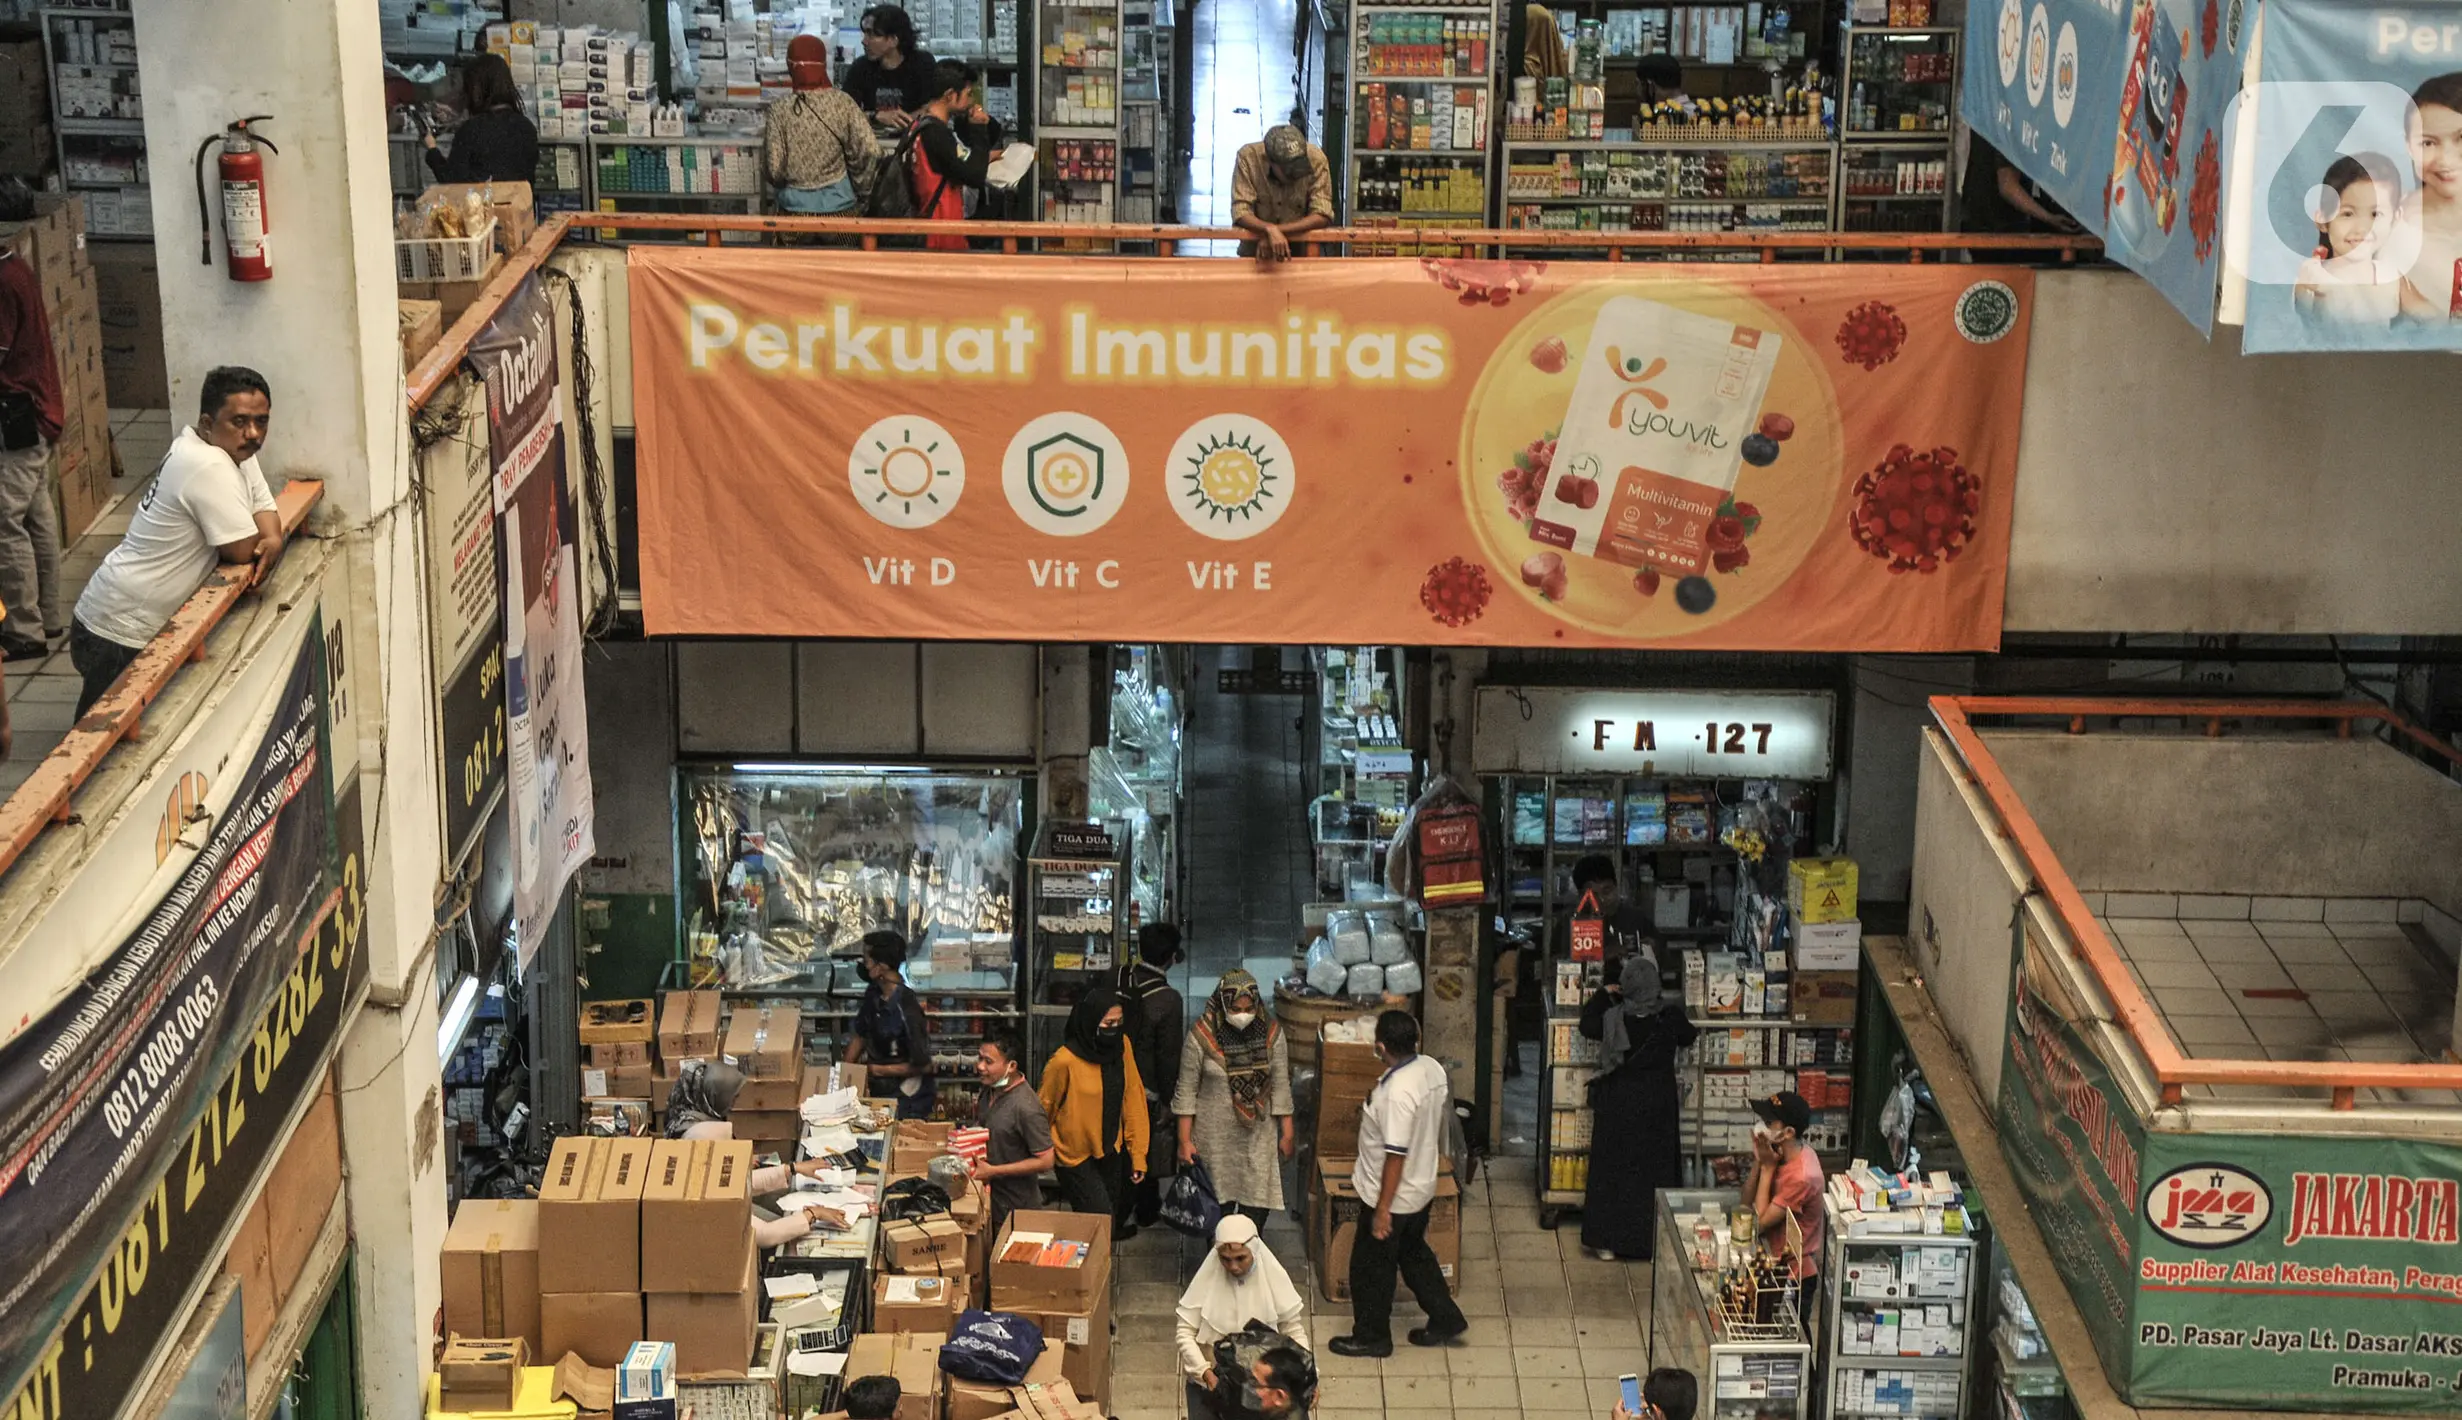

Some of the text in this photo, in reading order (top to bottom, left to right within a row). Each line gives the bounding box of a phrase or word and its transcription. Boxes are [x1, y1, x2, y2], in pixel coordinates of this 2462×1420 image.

[690, 304, 1446, 380] Perkuat Imunitas
[1629, 407, 1728, 449] youvit
[1627, 482, 1713, 517] Multivitamin
[864, 556, 956, 586] Vit D
[1028, 559, 1120, 588] Vit C
[1187, 561, 1272, 590] Vit E
[1594, 719, 1615, 751] F
[1706, 722, 1773, 755] 127
[1056, 834, 1108, 844] TIGA DUA
[218, 850, 257, 898] DENGAN
[1043, 862, 1099, 872] TIGA DUA
[94, 959, 141, 1010] DENGAN
[126, 901, 184, 968] KEBUTUHAN
[174, 862, 212, 909] MASKER
[191, 928, 211, 965] HAL
[207, 912, 224, 946] INI
[218, 901, 237, 931] KE
[1573, 937, 1602, 951] 30%
[103, 1067, 149, 1139] 0812
[139, 1019, 184, 1089] 8008
[177, 973, 219, 1041] 0063
[2160, 1173, 2461, 1246] jma JAKARTA
[2141, 1258, 2228, 1284] Supplier
[2232, 1261, 2275, 1283] Alat
[2281, 1263, 2399, 1291] Kesehatan,
[2140, 1324, 2176, 1346] PD.
[2183, 1325, 2245, 1348] Pasar
[2251, 1328, 2303, 1352] Jaya
[2309, 1330, 2338, 1351] Lt.
[2345, 1331, 2410, 1354] Dasar
[2333, 1366, 2431, 1391] Pramuka
